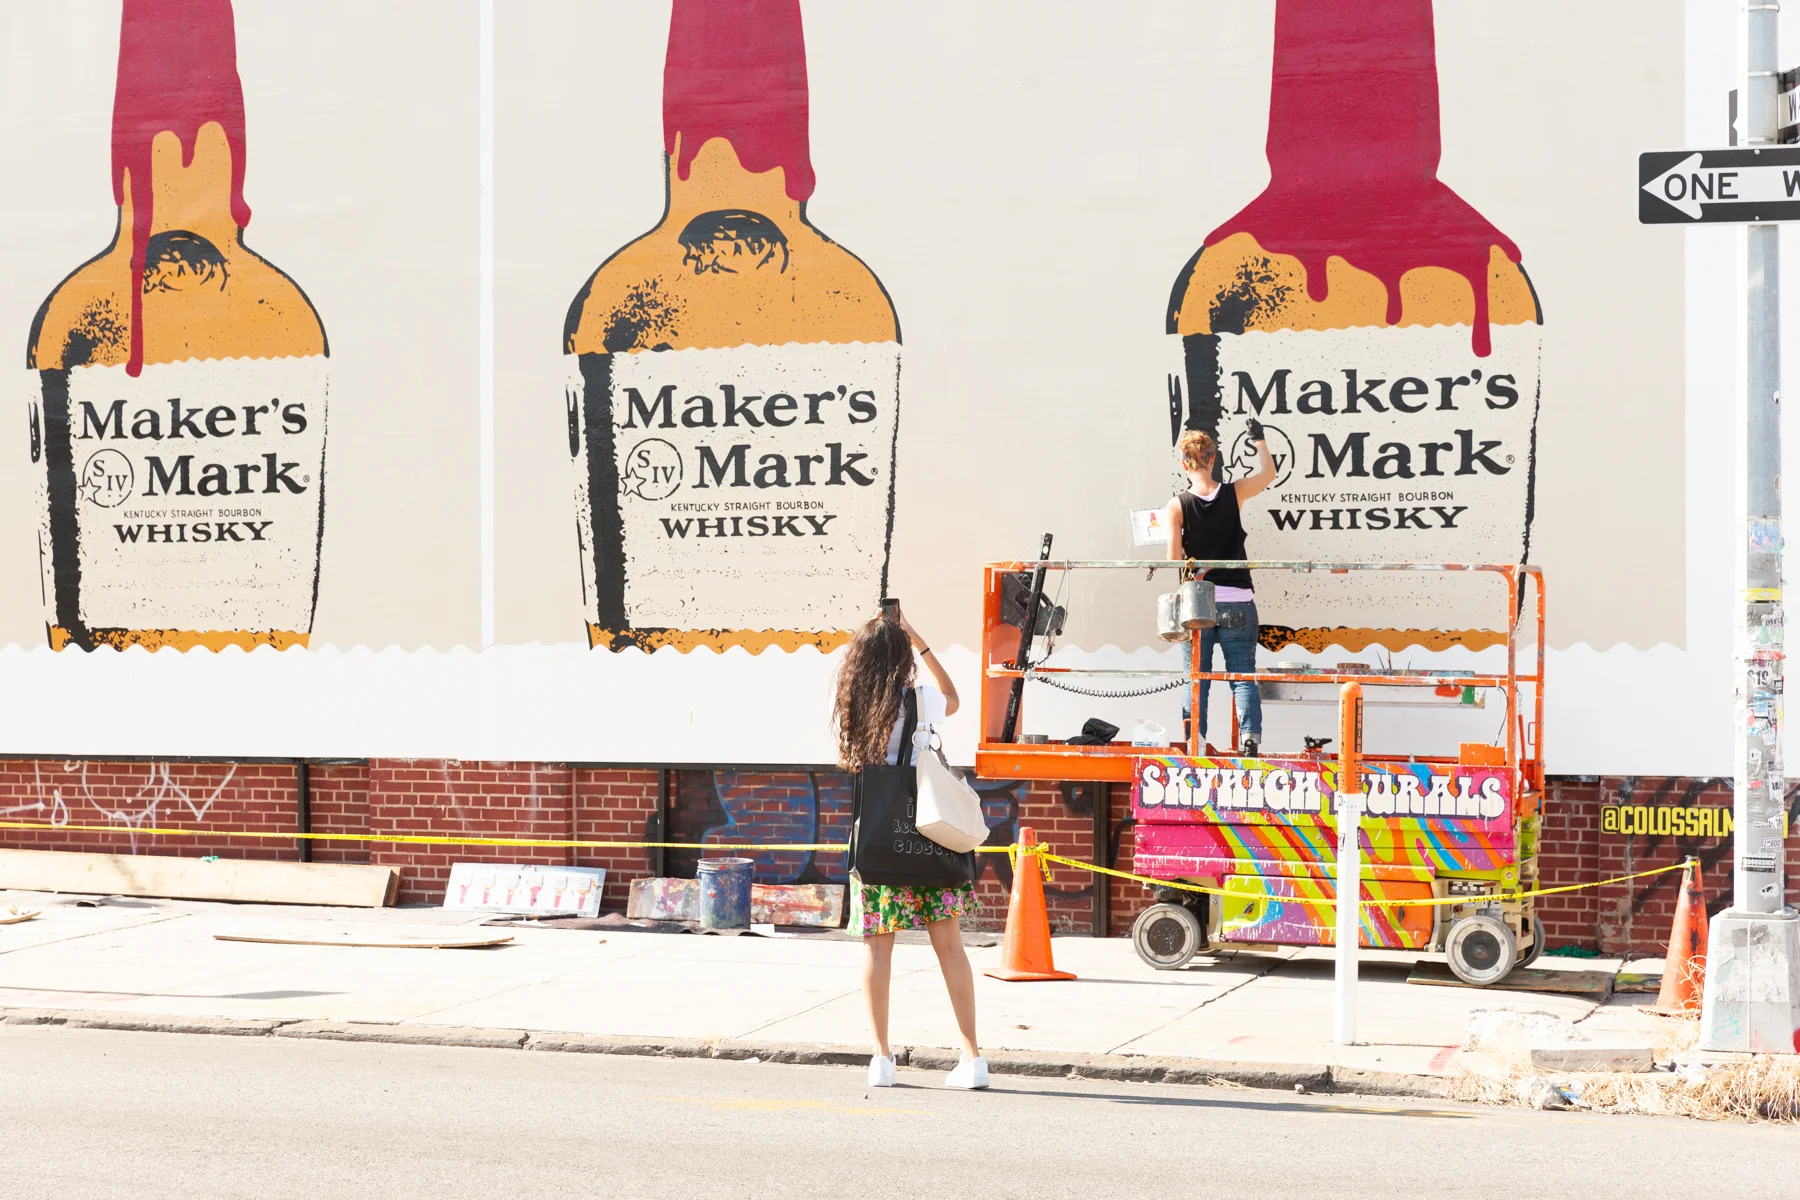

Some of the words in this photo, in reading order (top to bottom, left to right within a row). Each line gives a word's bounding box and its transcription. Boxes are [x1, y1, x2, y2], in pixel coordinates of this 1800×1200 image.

[1664, 172, 1739, 201] ONE
[1230, 368, 1519, 416] Maker's
[621, 384, 878, 429] Maker's
[78, 398, 308, 441] Maker's
[670, 503, 720, 512] KENTUCKY
[723, 501, 771, 511] STRAIGHT
[776, 501, 824, 510] BOURBON
[1281, 493, 1336, 503] KENTUCKY
[1340, 492, 1392, 503] STRAIGHT
[1398, 491, 1454, 502] BOURBON
[124, 510, 168, 519] KENTUCKY
[171, 509, 214, 518] STRAIGHT
[218, 508, 262, 517] BOURBON
[1267, 506, 1468, 531] WHISKY
[113, 521, 274, 543] WHISKY
[659, 515, 837, 539] WHISKY
[1140, 765, 1321, 812] SKYHIGH
